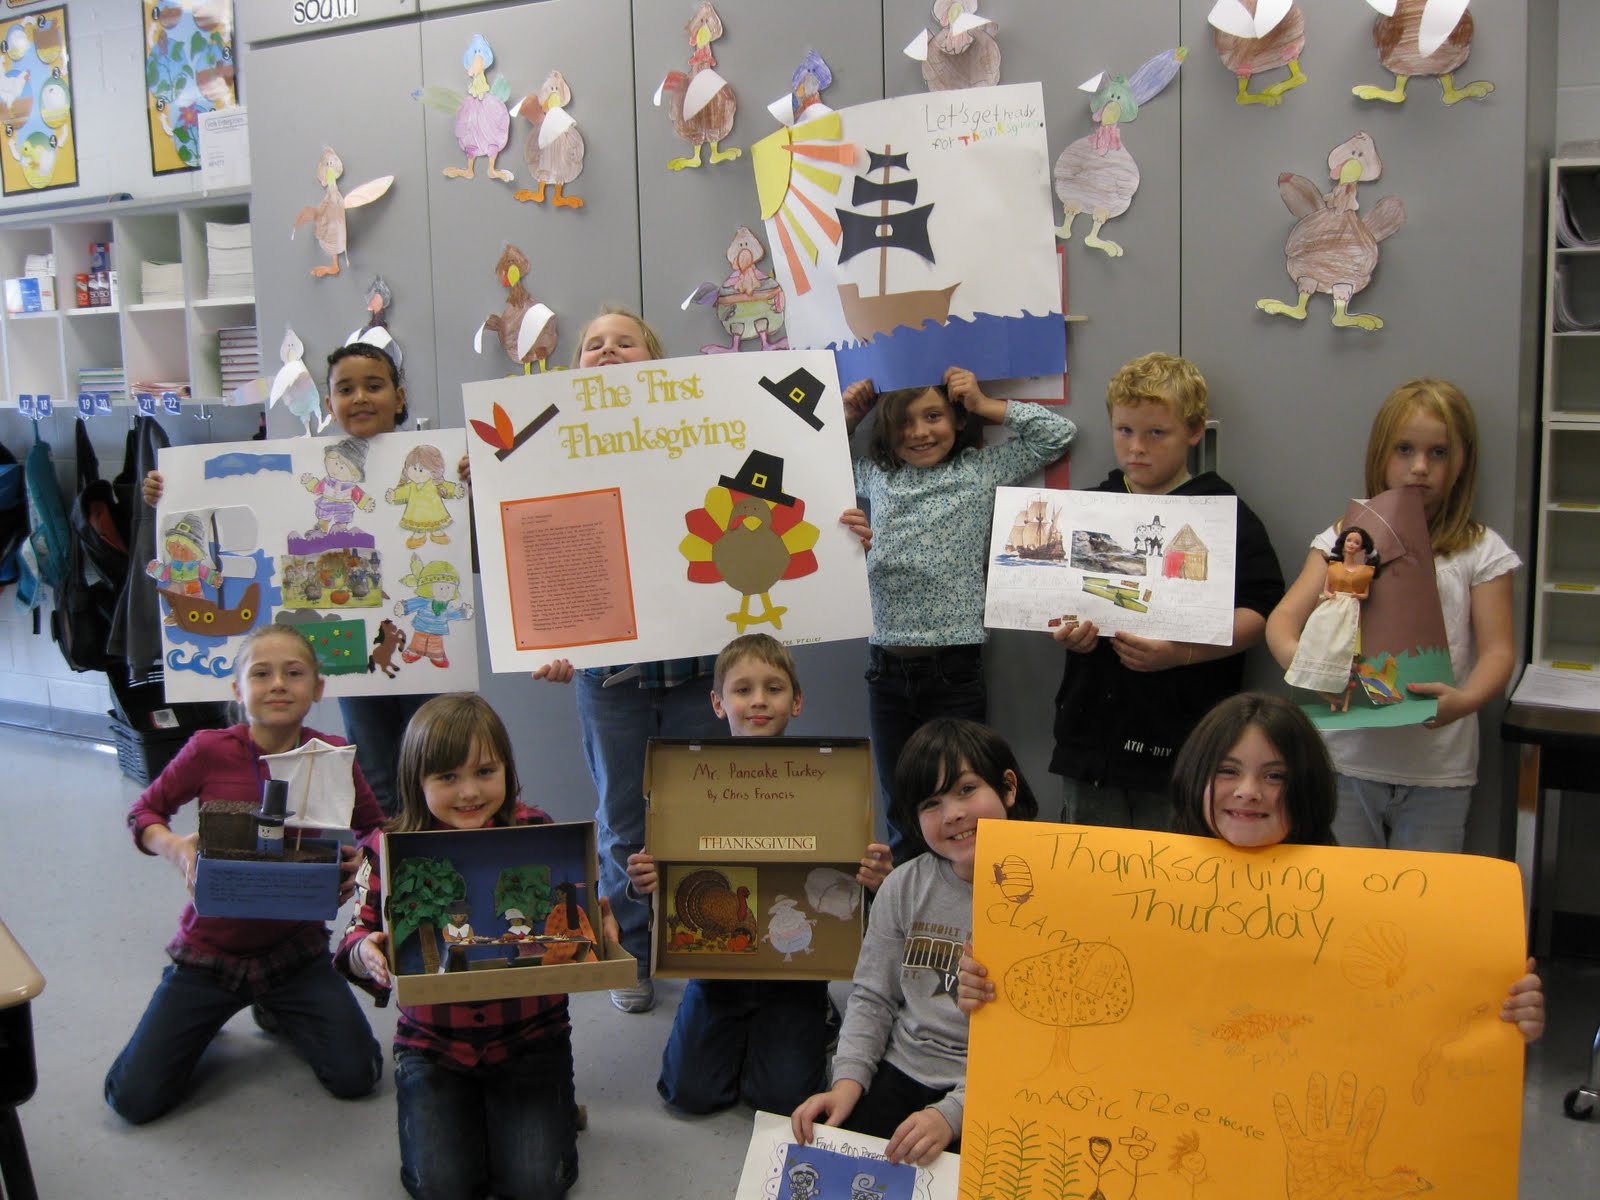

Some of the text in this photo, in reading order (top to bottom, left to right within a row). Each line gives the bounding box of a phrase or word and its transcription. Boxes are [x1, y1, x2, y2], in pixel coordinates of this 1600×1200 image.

[932, 137, 954, 151] for
[100, 290, 110, 298] 50
[572, 368, 704, 412] The First
[558, 416, 747, 460] Thanksgiving
[693, 760, 827, 781] Mr. Pancake Turkey
[707, 787, 795, 803] By Chris Francis
[701, 836, 815, 850] THANKSGIVING
[1035, 832, 1427, 912] Thanksgiving on
[1112, 888, 1336, 965] Thursday
[945, 973, 956, 992] V
